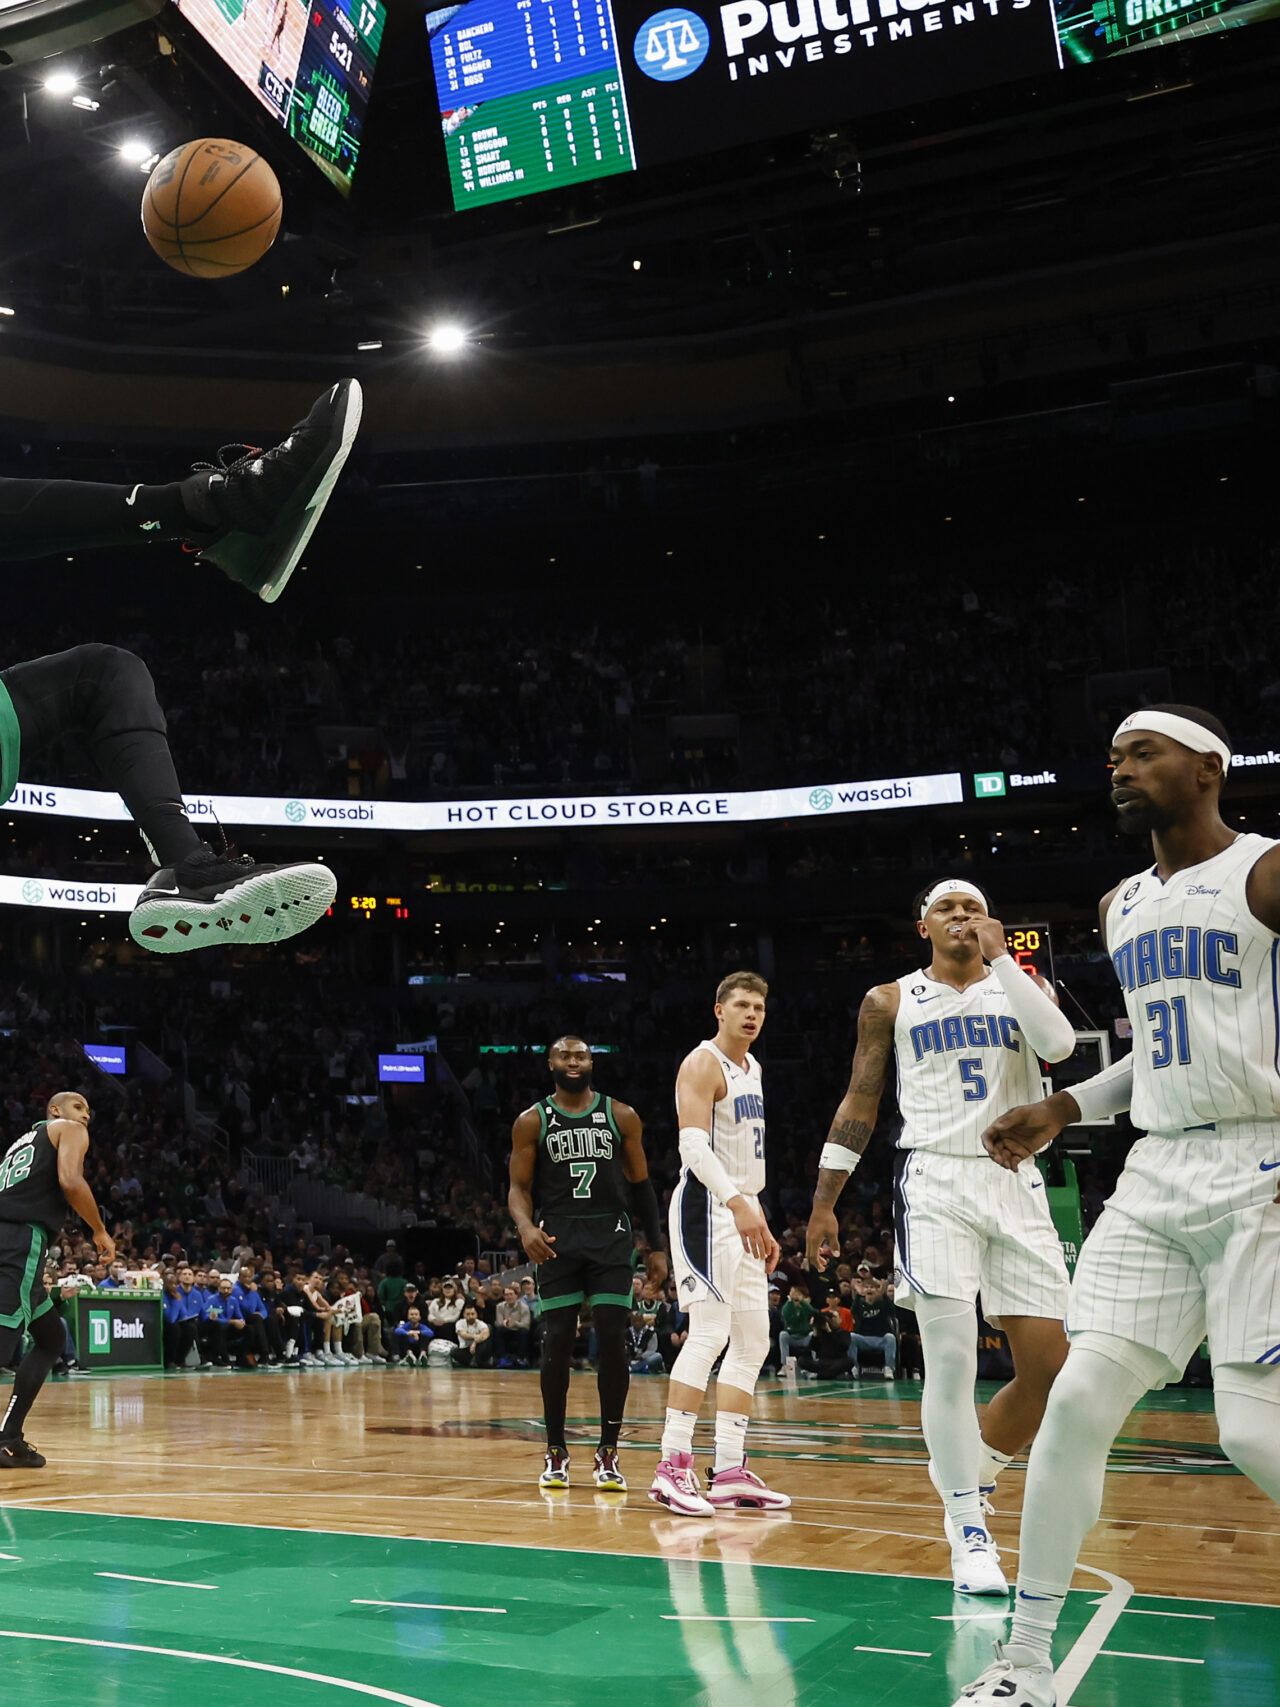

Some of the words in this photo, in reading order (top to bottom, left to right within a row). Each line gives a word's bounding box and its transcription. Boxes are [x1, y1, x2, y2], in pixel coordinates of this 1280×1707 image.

[359, 3, 377, 36] 17
[456, 22, 494, 41] BANCHERO
[524, 12, 531, 22] 3
[720, 0, 947, 57] Putn
[329, 30, 352, 72] 5:21
[458, 40, 474, 52] BOL
[526, 24, 532, 34] 2
[445, 56, 456, 68] 20
[460, 49, 482, 64] FULTZ
[448, 69, 457, 80] 21
[462, 59, 492, 75] WAGNER
[553, 40, 560, 51] 3
[450, 80, 459, 91] 31
[464, 73, 484, 86] ROSS
[532, 100, 547, 110] PTS
[556, 94, 572, 105] REB
[581, 87, 597, 98] AST
[604, 82, 619, 92] FLS
[316, 84, 342, 124] BLEED
[308, 107, 340, 148] GREEN
[459, 134, 465, 146] 7
[472, 126, 498, 142] BROWN
[540, 114, 546, 125] 3
[474, 136, 508, 153] BROGDON
[475, 150, 500, 165] SMART
[592, 126, 598, 136] 3
[477, 160, 511, 176] HORFORD
[479, 170, 514, 188] WILLIAMS
[1232, 750, 1280, 767] Bank
[838, 782, 912, 804] wasabi
[978, 776, 1003, 793] TD
[1010, 770, 1056, 787] Bank
[310, 803, 374, 822] wasabi
[447, 806, 498, 823] HOT
[509, 802, 596, 820] CLOUD
[608, 798, 729, 819] STORAGE
[48, 885, 116, 904] wasabi
[351, 896, 376, 909] 5:20
[1186, 885, 1222, 898] Disney
[1006, 931, 1040, 950] :20
[1113, 926, 1242, 994] MAGIC
[910, 1015, 1020, 1062] MAGIC
[1146, 996, 1191, 1069] 31
[959, 1058, 988, 1101] 5
[546, 1128, 612, 1163] CELTICS
[570, 1162, 597, 1198] 7
[91, 1318, 108, 1345] TD
[113, 1318, 144, 1338] Bank
